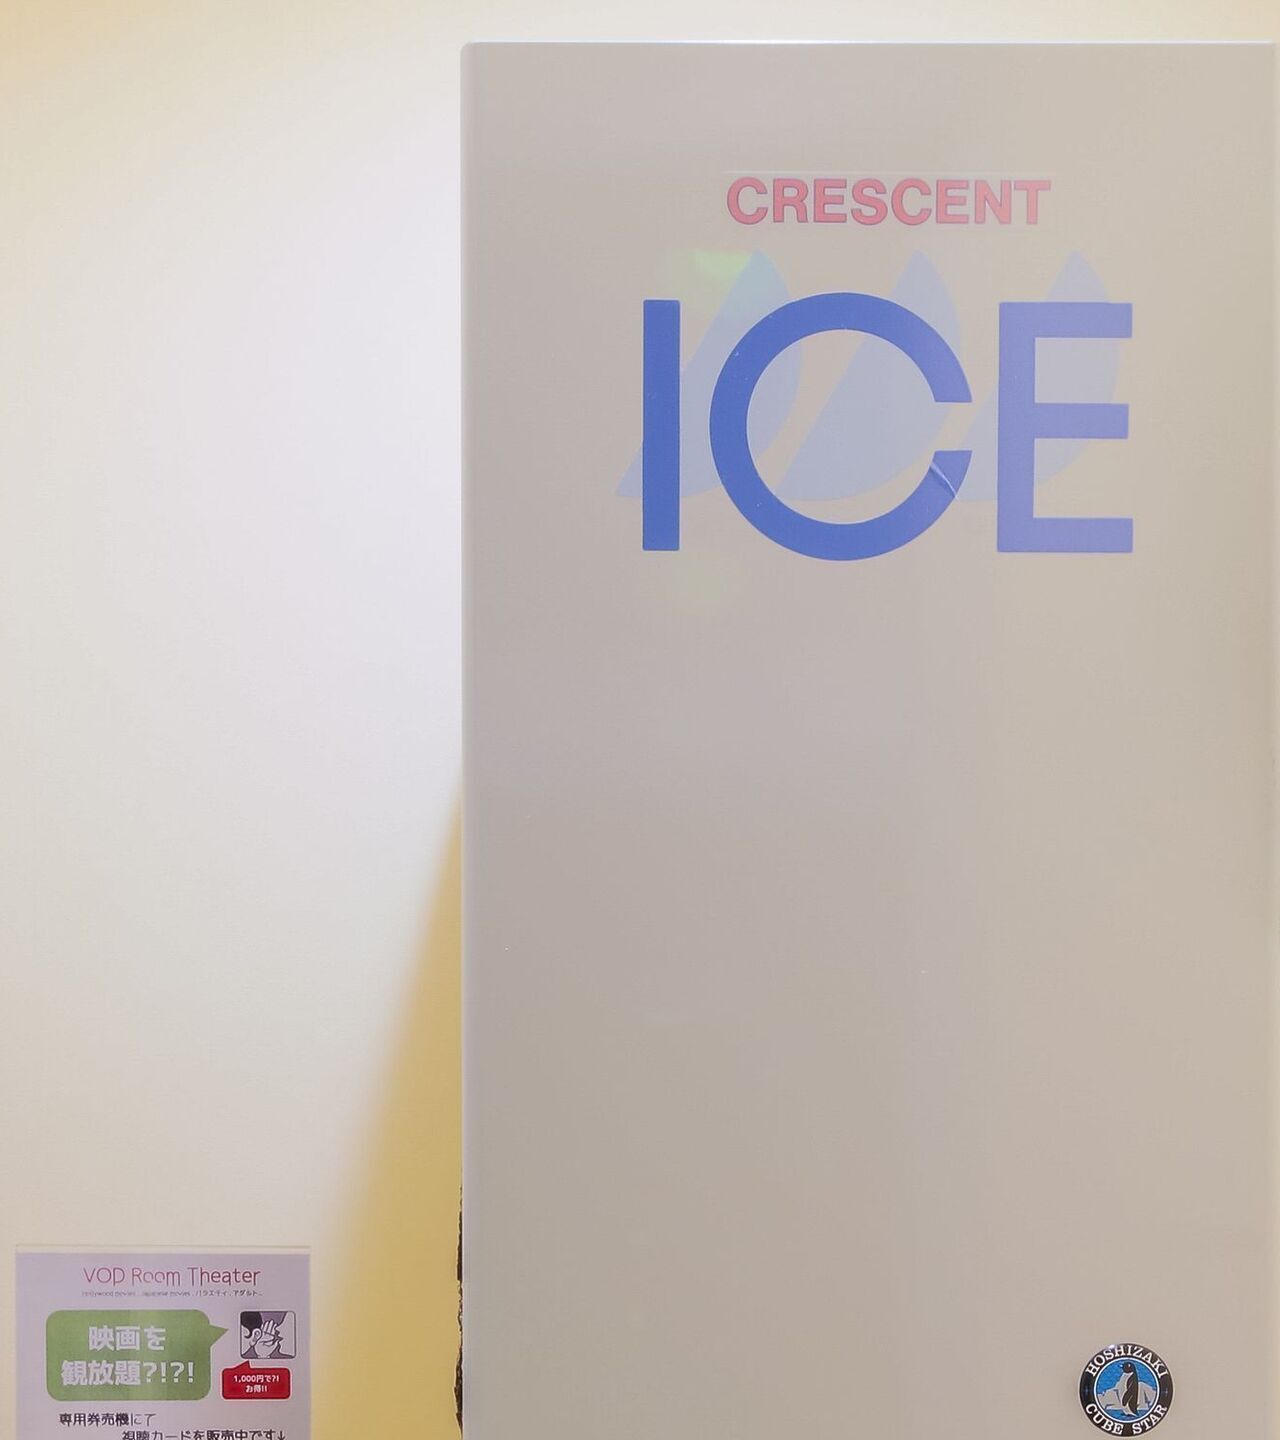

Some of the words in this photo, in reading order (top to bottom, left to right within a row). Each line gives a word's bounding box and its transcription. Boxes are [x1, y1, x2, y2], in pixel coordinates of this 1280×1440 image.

[726, 176, 1052, 226] CRESCENT
[642, 291, 1134, 562] ICE
[82, 1266, 126, 1286] VOD
[131, 1266, 181, 1286] Room
[187, 1266, 262, 1287] Theater
[87, 1325, 166, 1351] 映画を
[1085, 1344, 1169, 1379] HOSHIZAKI
[59, 1412, 156, 1427] 専用券売機にて
[1085, 1403, 1124, 1435] CUBE
[1132, 1404, 1168, 1435] STAR
